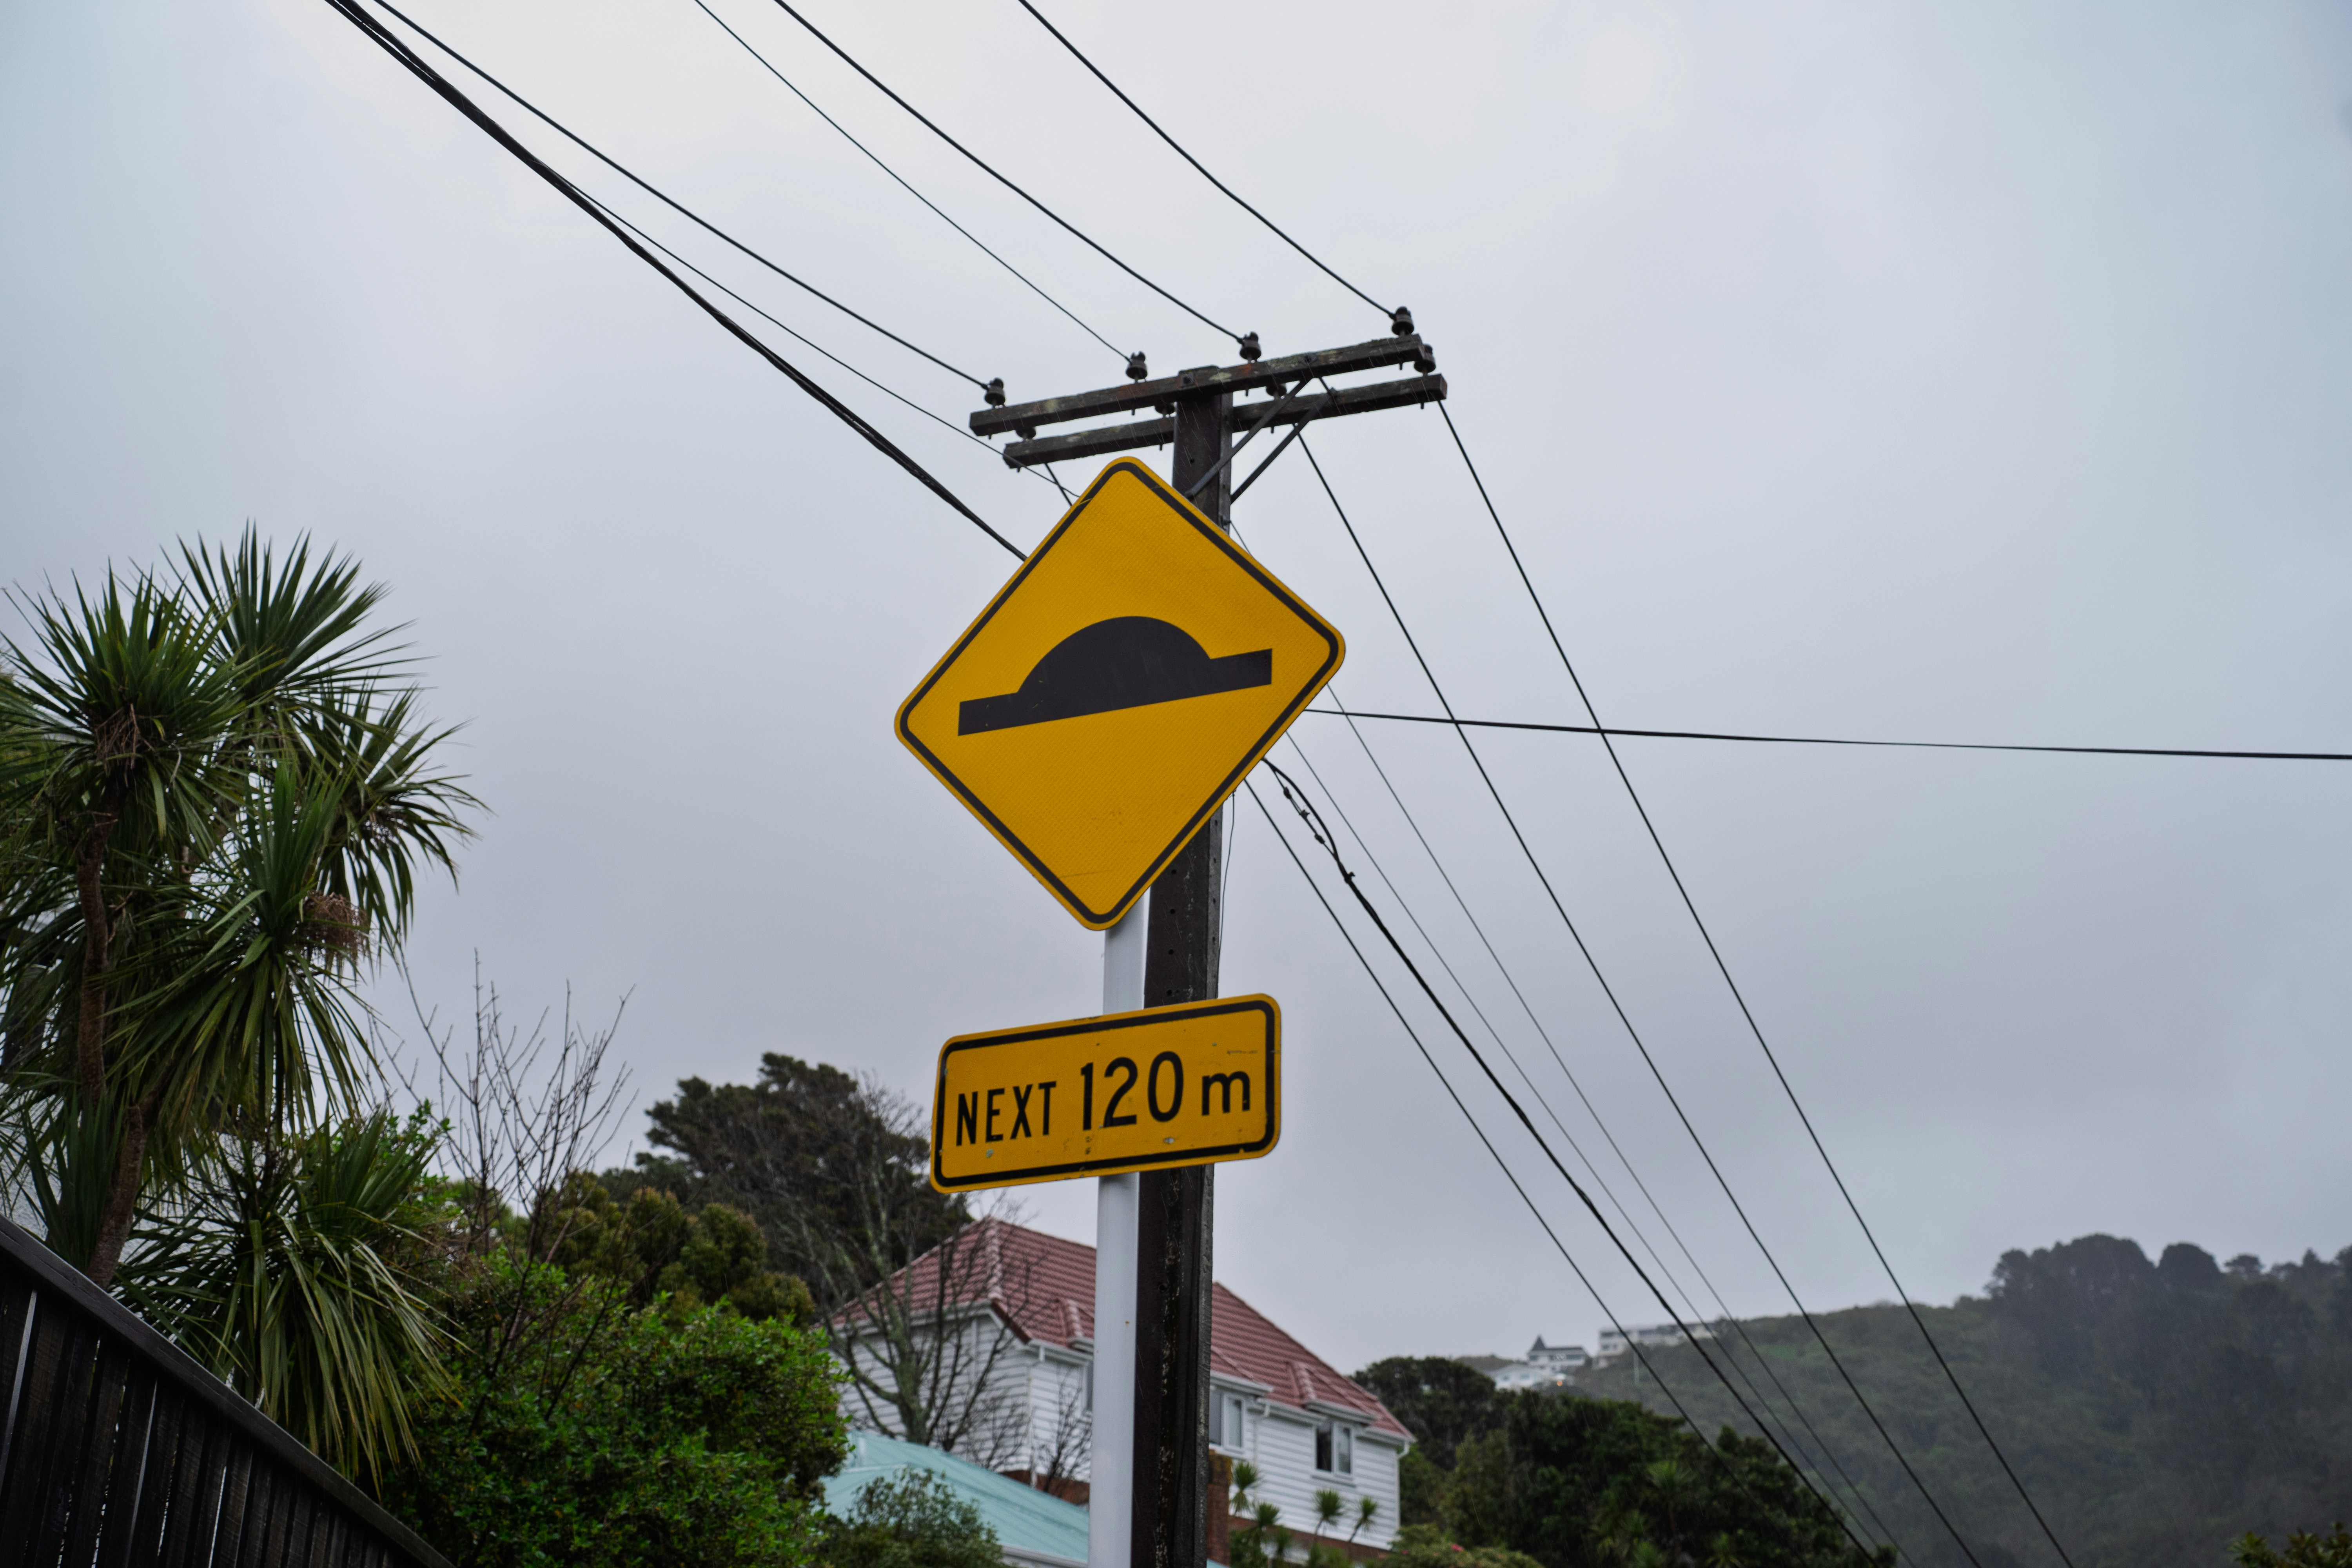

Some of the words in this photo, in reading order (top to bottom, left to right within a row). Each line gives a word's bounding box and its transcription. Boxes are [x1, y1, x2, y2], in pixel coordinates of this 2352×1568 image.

[956, 1081, 1057, 1147] NEXT
[1080, 1051, 1184, 1131] 120
[1201, 1071, 1250, 1116] m
